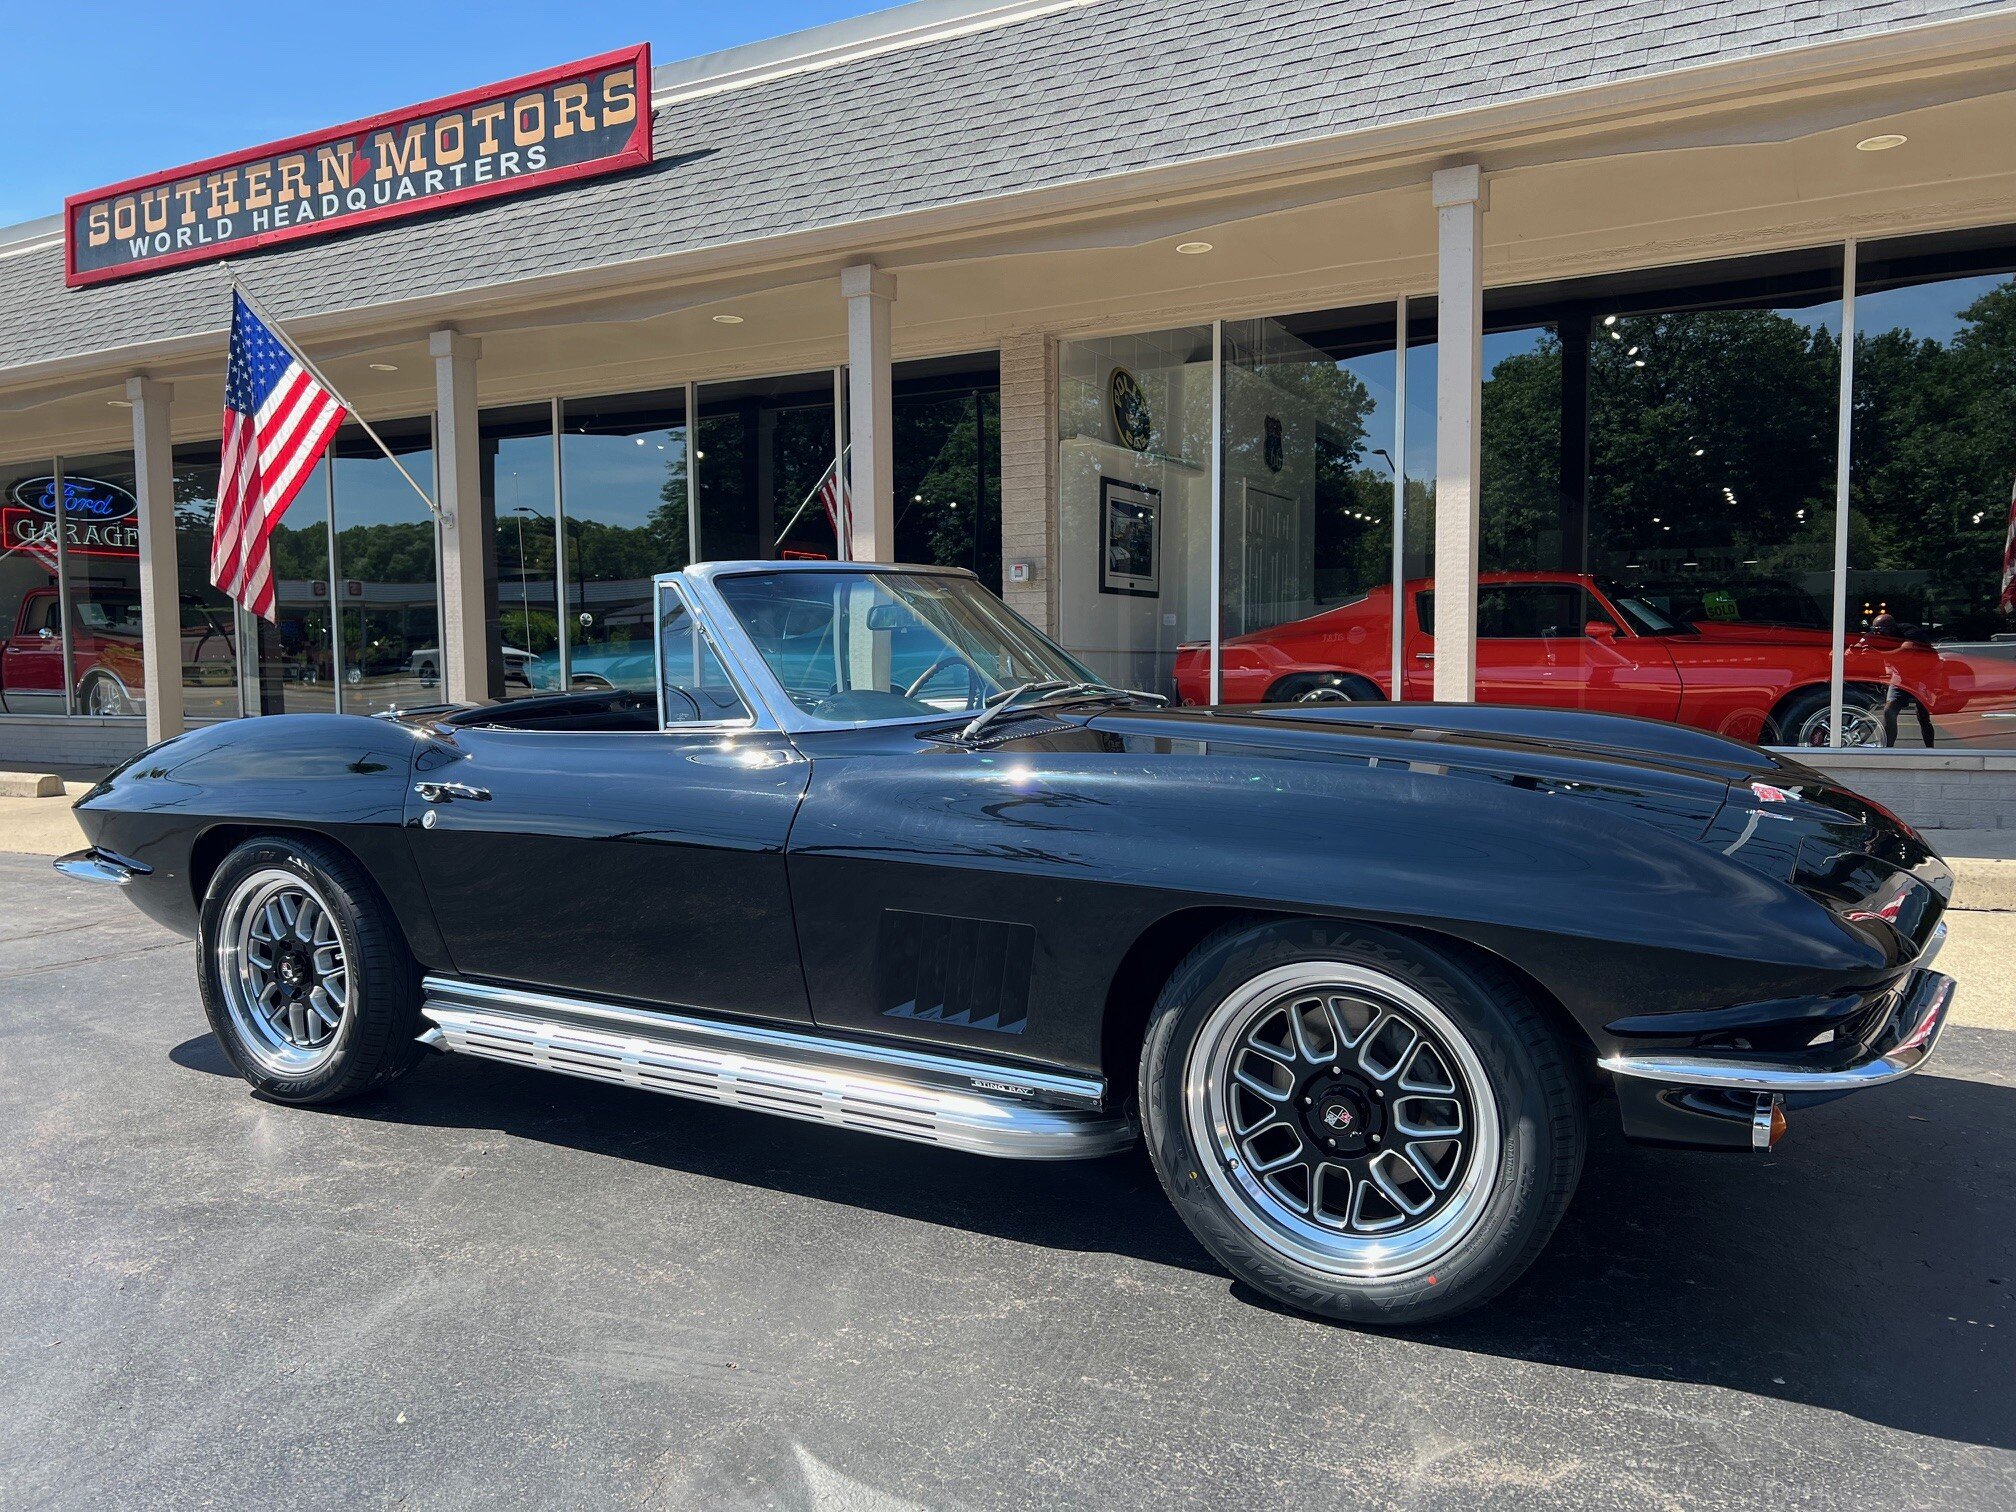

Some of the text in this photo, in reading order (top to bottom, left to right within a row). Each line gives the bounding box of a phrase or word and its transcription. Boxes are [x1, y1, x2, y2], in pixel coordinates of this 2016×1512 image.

[88, 69, 637, 247] SOUTHERN MOTORS
[129, 145, 547, 259] WORLD HEADQUARTERS
[38, 482, 114, 515] Ford
[1707, 604, 1736, 617] SOLD
[974, 1080, 1029, 1095] STING RAY
